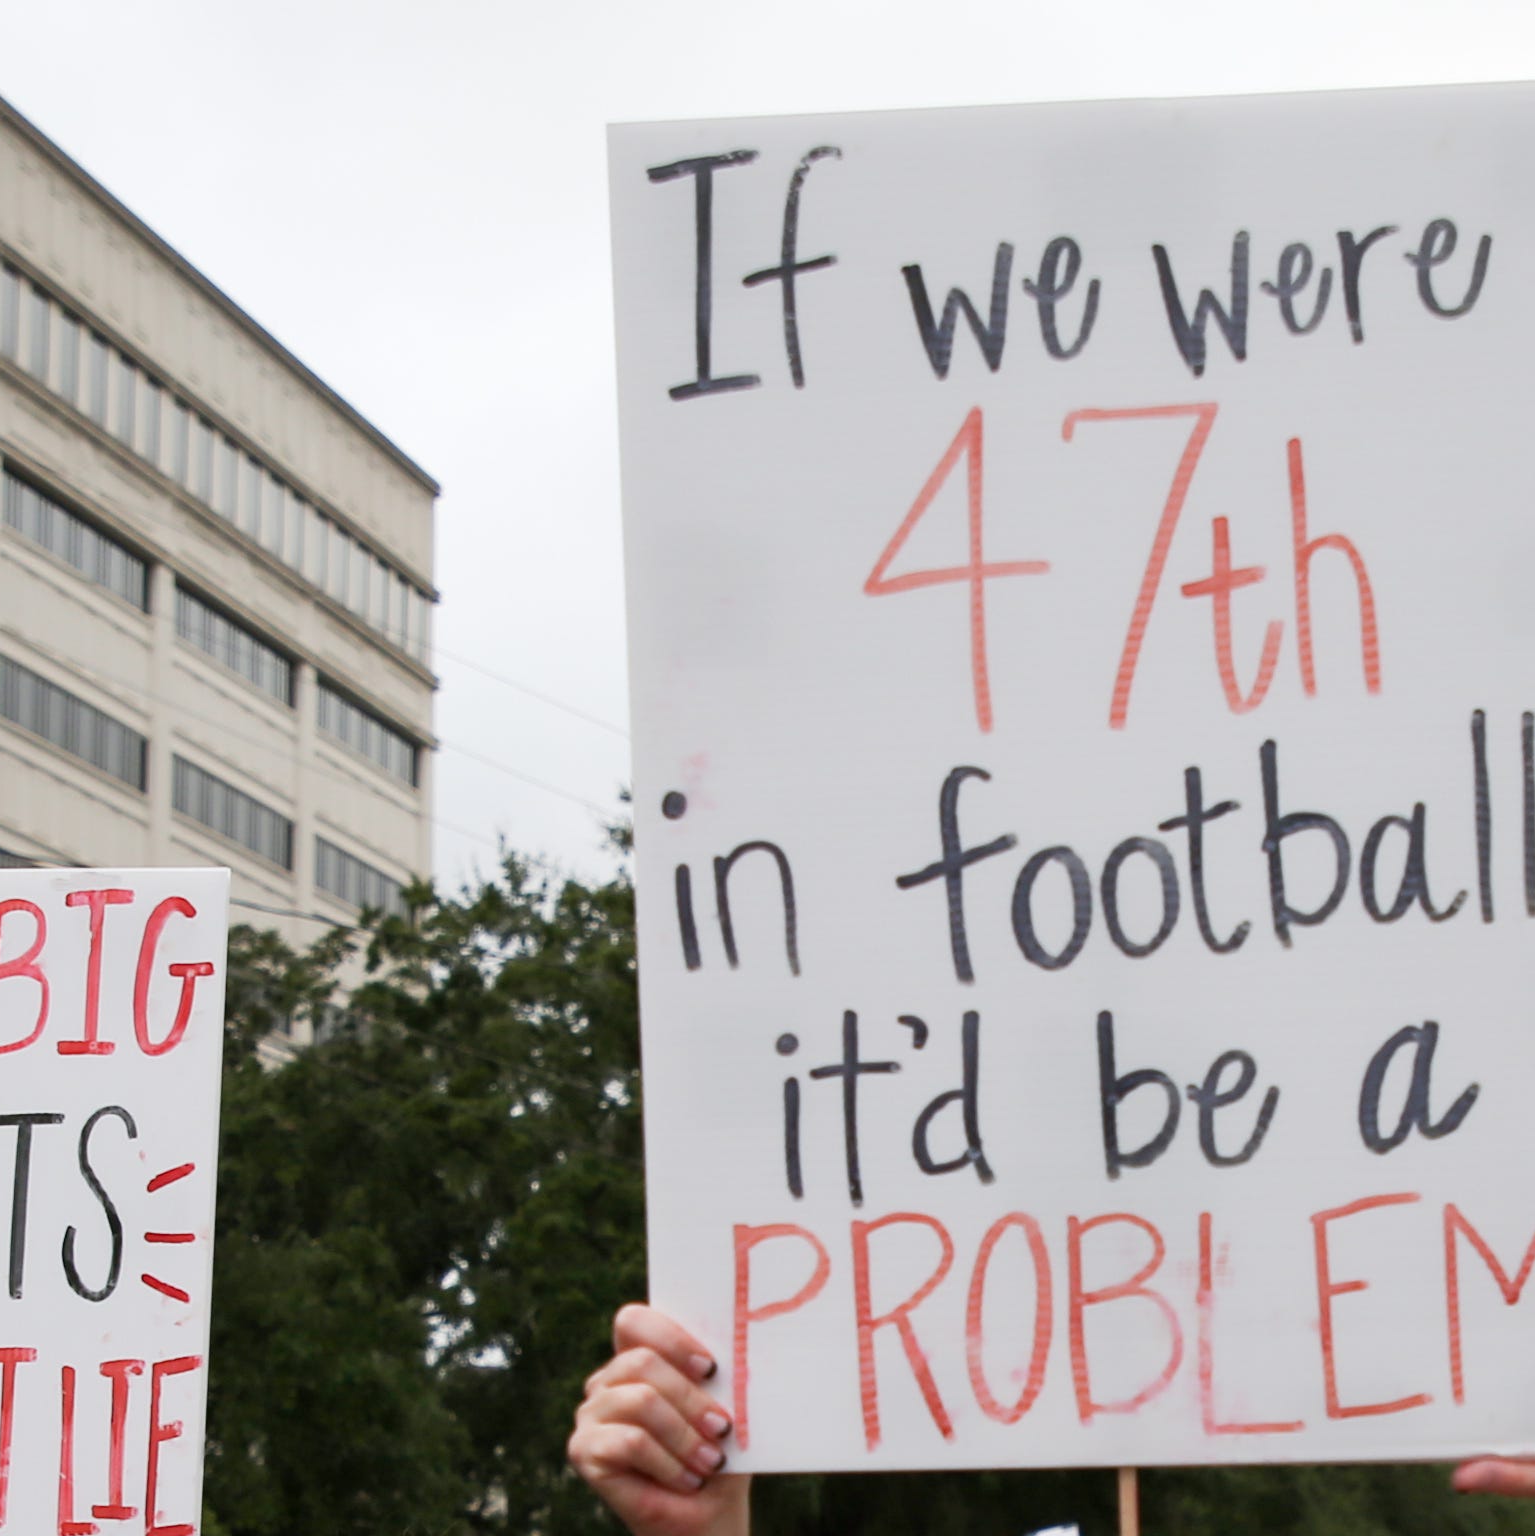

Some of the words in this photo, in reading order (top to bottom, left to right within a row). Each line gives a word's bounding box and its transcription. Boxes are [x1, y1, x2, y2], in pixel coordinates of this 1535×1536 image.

[648, 146, 842, 401] If
[903, 235, 1101, 381] we
[1152, 218, 1493, 378] were
[862, 402, 1384, 733] 47th
[661, 789, 802, 979] in
[773, 1009, 995, 1208] it'd
[1096, 1009, 1279, 1180] be
[1360, 1018, 1480, 1156] a
